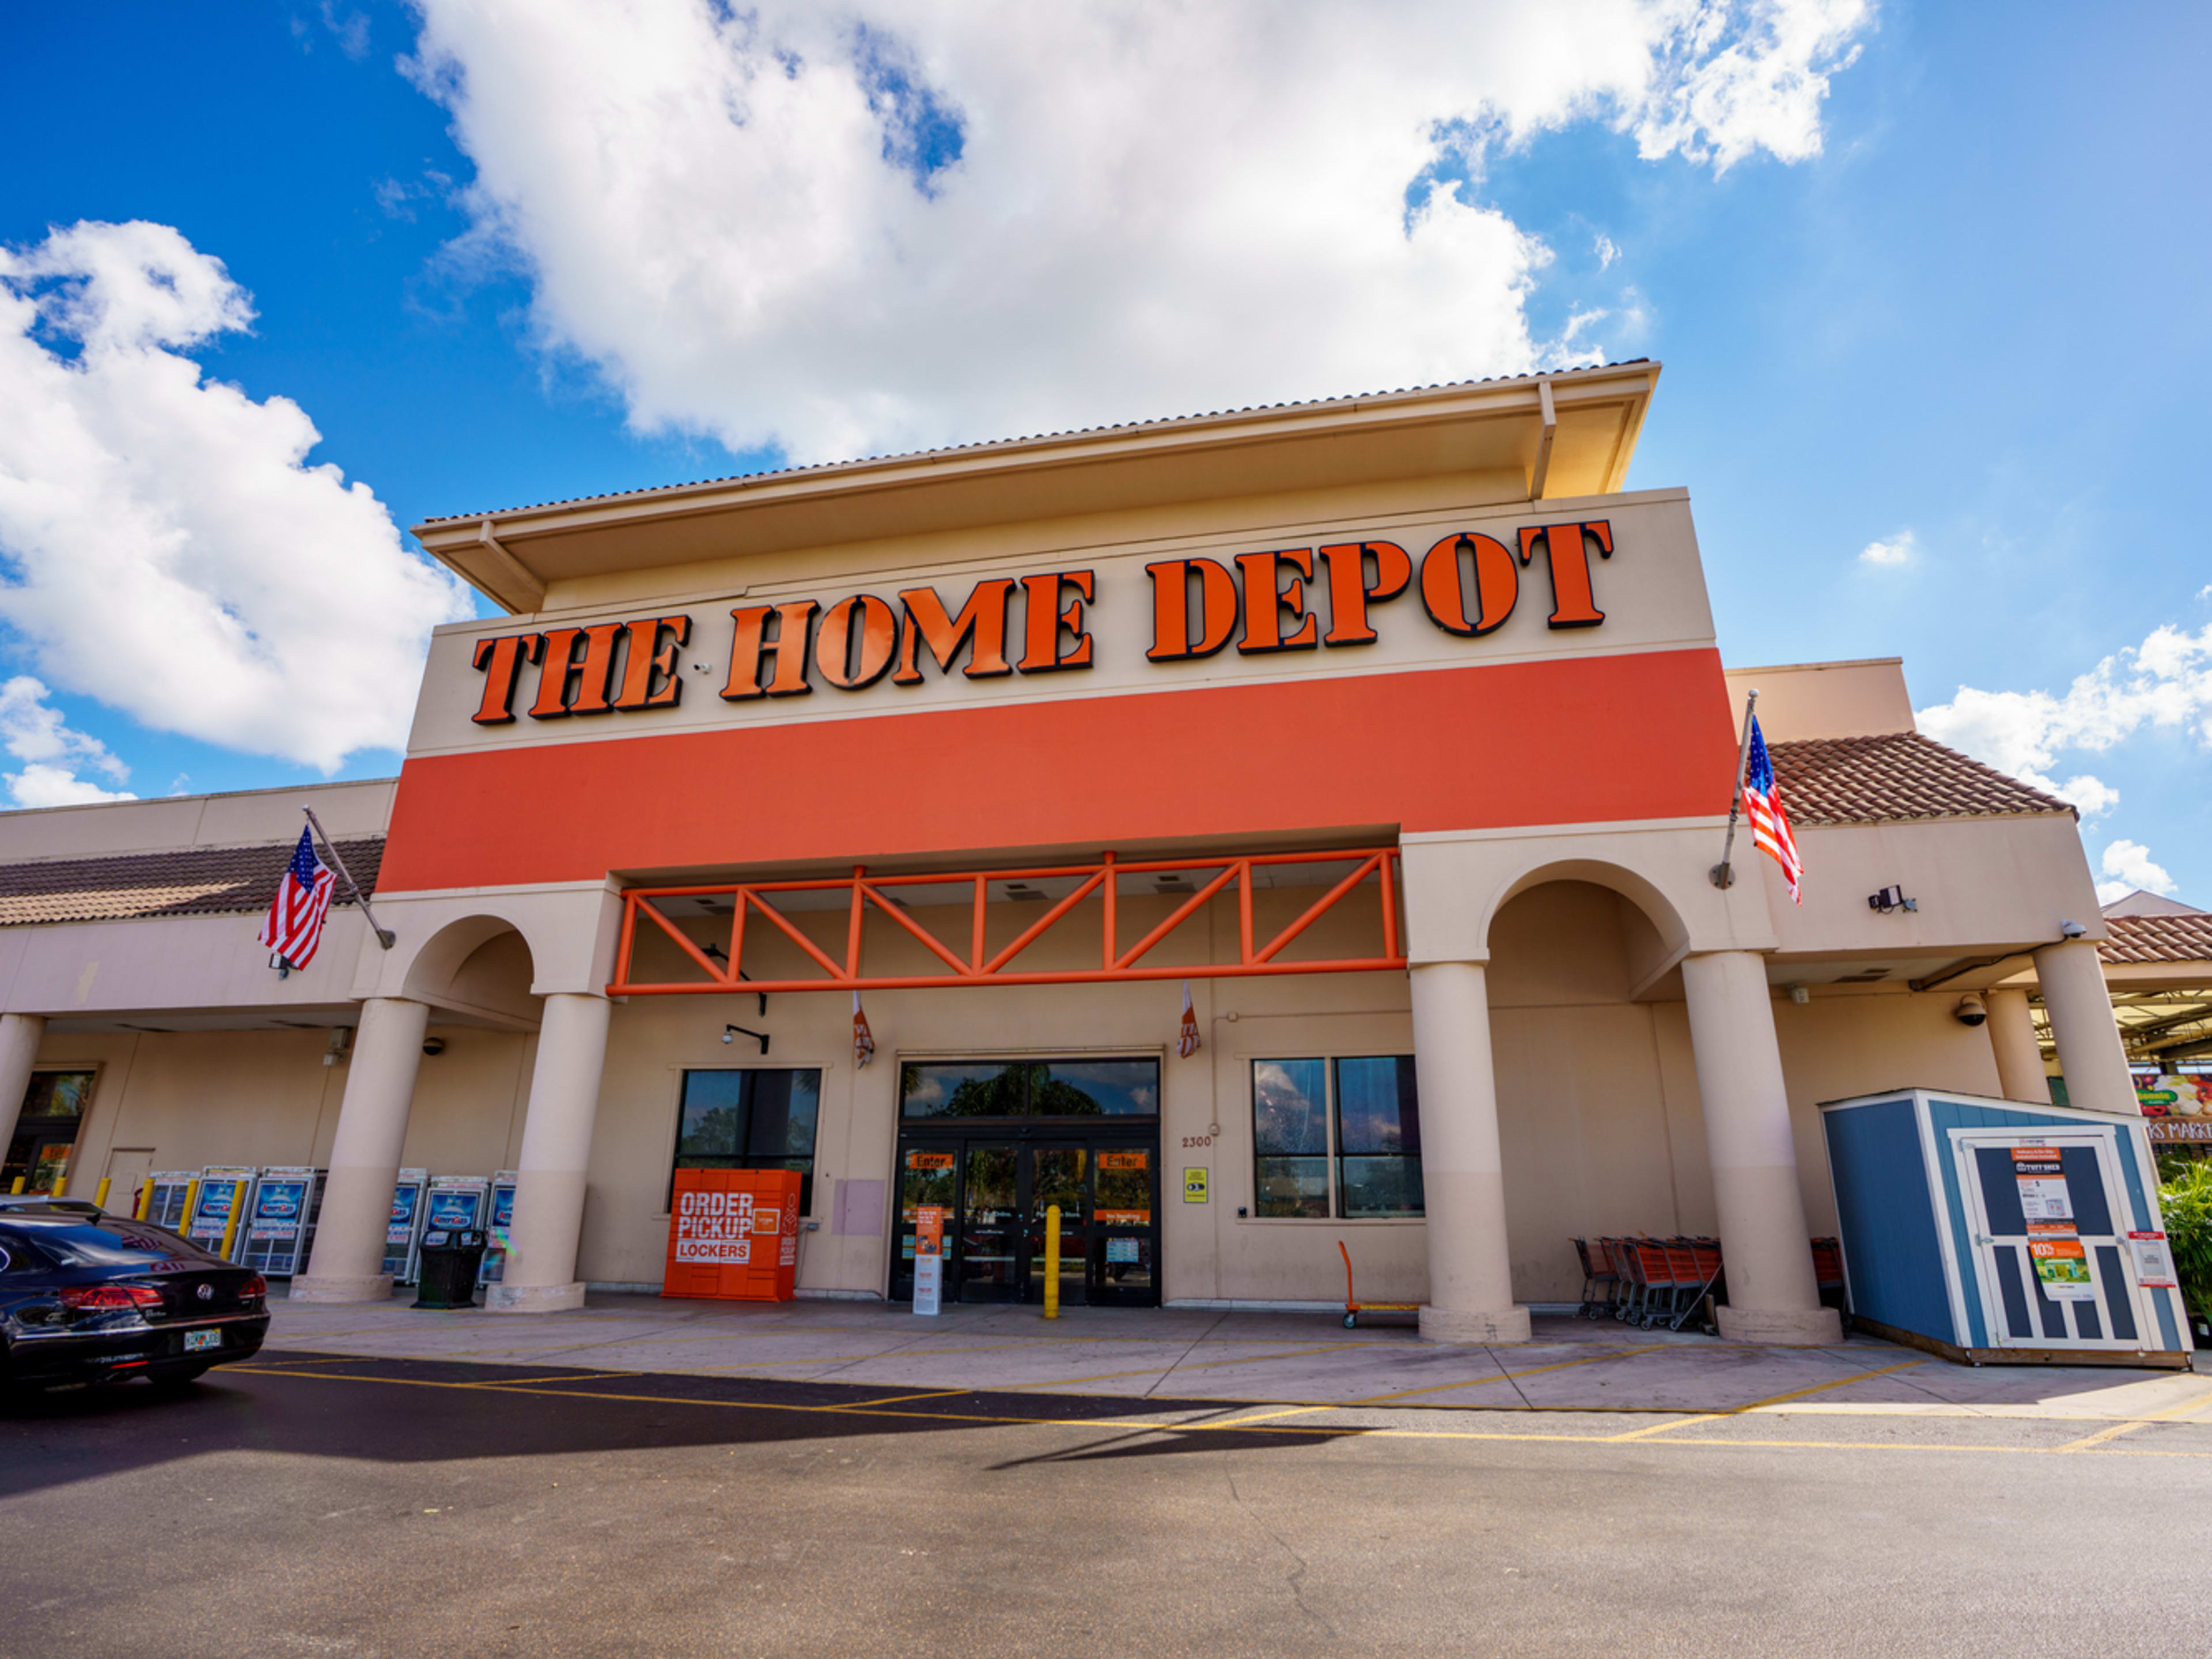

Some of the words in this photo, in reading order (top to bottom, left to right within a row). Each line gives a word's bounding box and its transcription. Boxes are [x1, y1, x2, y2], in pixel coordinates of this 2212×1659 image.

[471, 614, 692, 726] THE
[719, 569, 1095, 702] HOME
[1145, 520, 1614, 663] DEPOT
[1183, 1137, 1211, 1147] 2300
[917, 1156, 946, 1167] Enter
[1107, 1156, 1138, 1167] Enter
[203, 1203, 230, 1212] AmeriG
[680, 1192, 753, 1216] ORDER
[678, 1216, 752, 1238] PICKUP
[680, 1244, 747, 1257] LOCKERS
